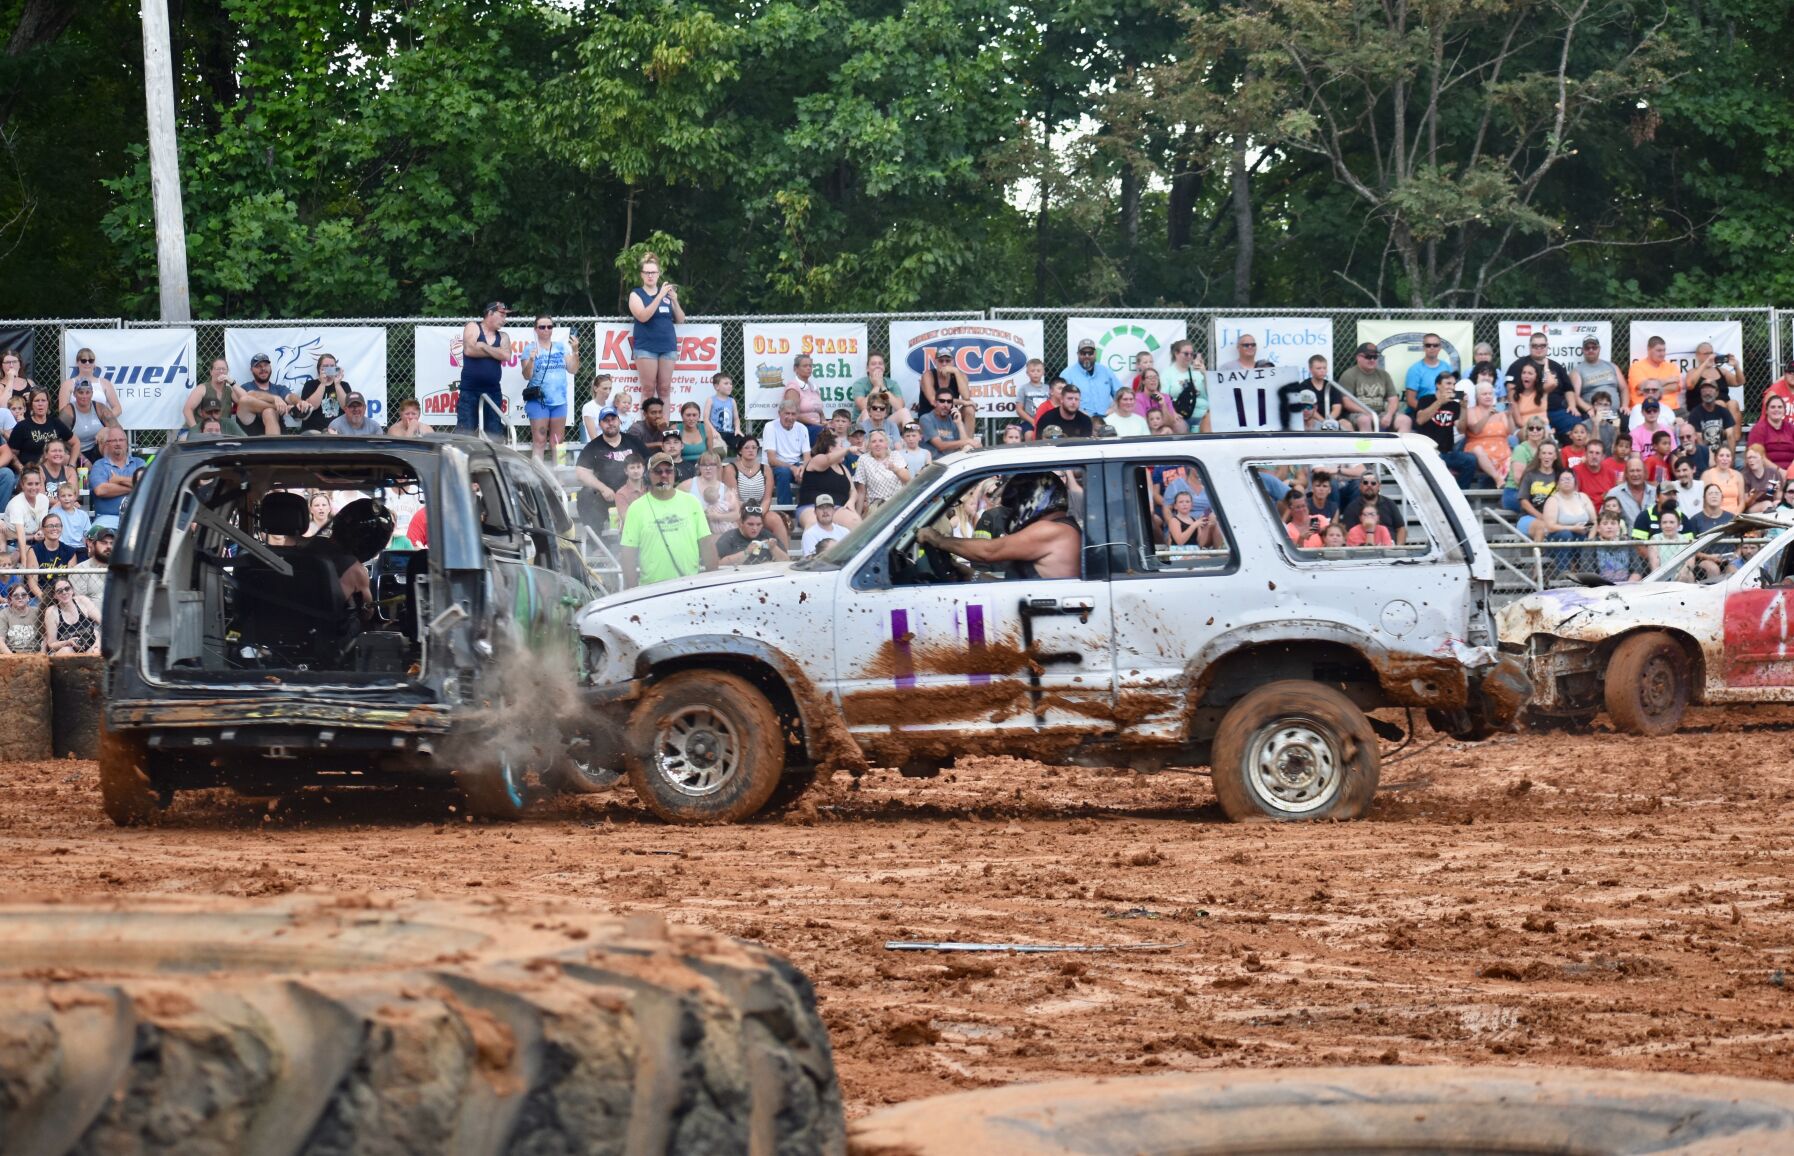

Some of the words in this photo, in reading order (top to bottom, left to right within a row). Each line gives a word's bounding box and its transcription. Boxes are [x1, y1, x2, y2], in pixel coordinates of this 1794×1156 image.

[801, 335, 858, 355] STAGE
[1264, 329, 1327, 348] Jacobs
[811, 358, 852, 378] ash
[1217, 369, 1275, 383] DAVIS
[820, 386, 853, 401] use
